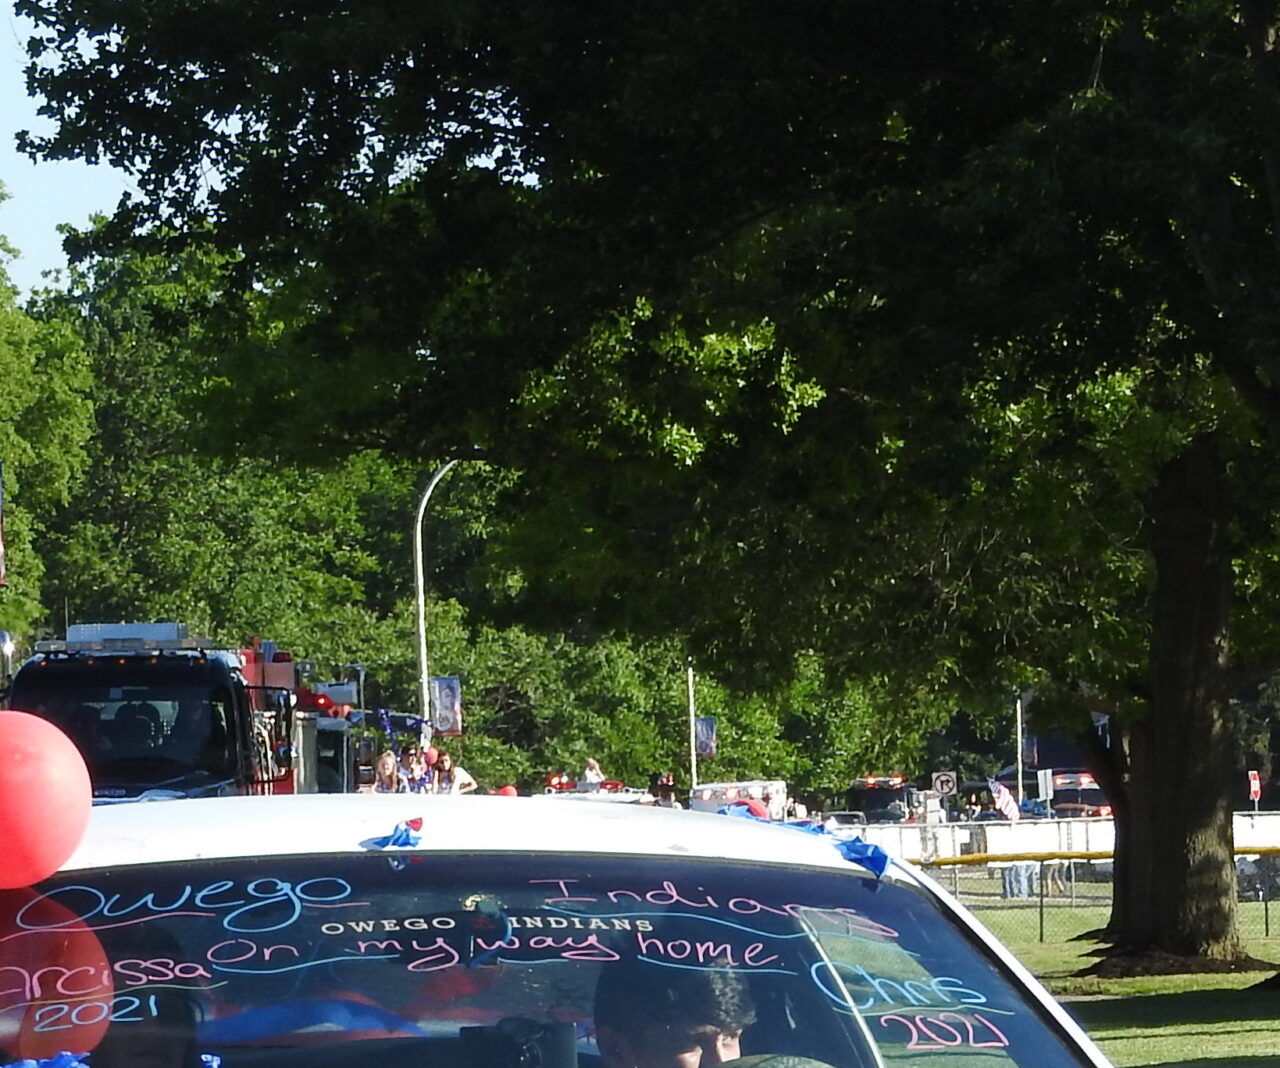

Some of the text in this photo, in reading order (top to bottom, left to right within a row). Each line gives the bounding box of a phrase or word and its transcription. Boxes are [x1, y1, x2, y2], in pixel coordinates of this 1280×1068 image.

[15, 877, 900, 938] Owego Indians
[320, 915, 655, 936] OWEGO INDIANS
[206, 939, 300, 964] On
[357, 935, 460, 972] my
[475, 933, 621, 962] way
[33, 994, 158, 1032] 2021
[880, 1012, 1010, 1050] 2021
